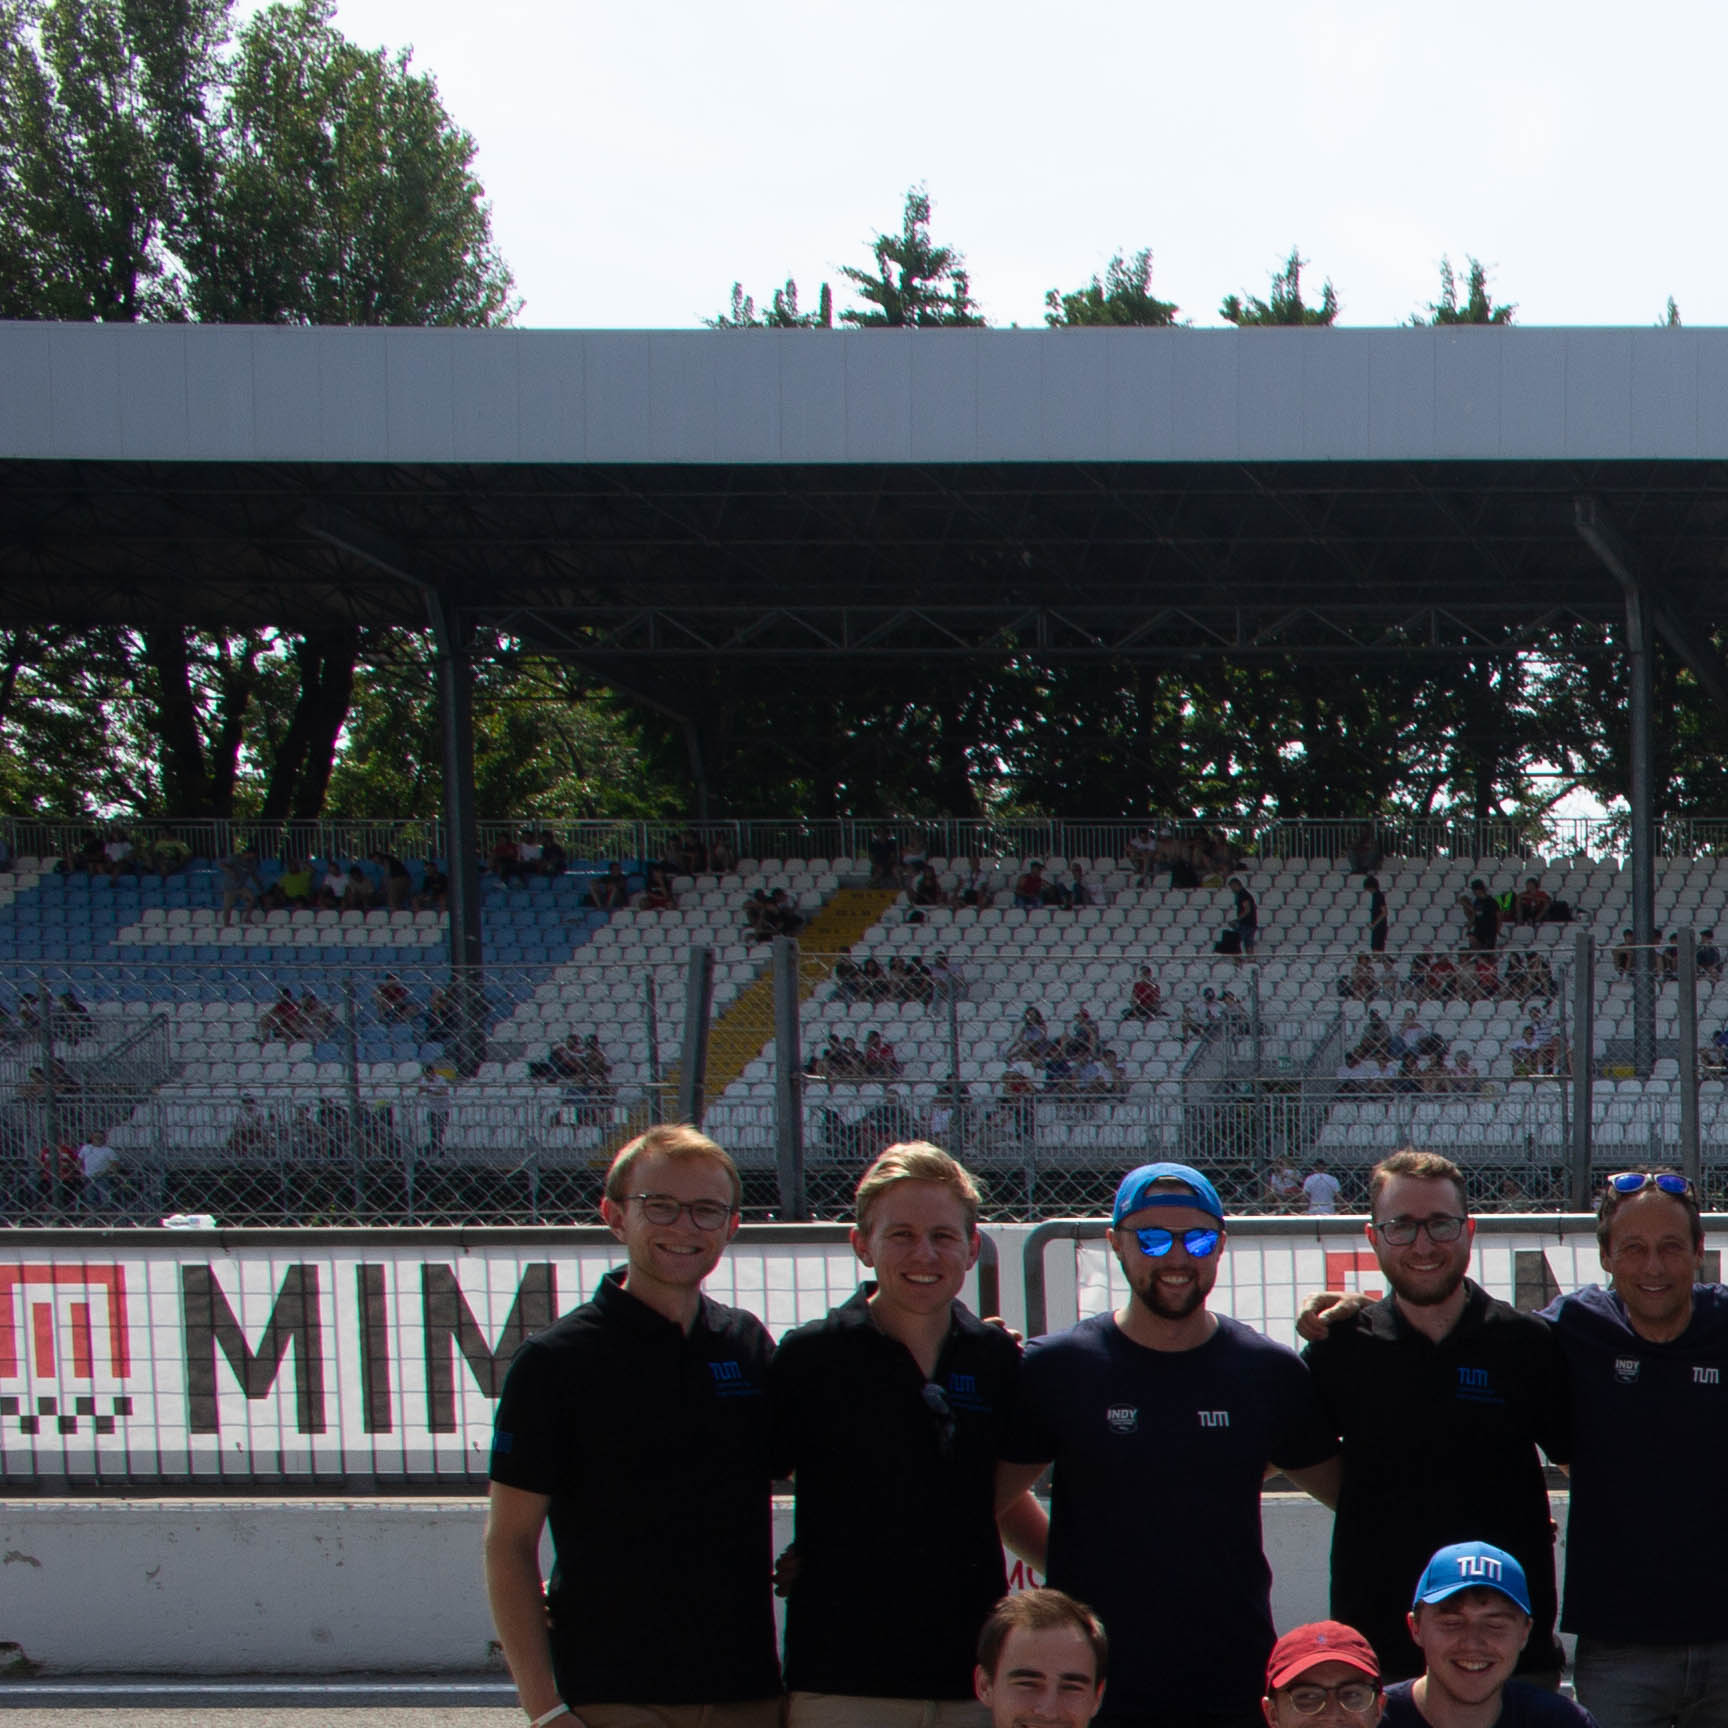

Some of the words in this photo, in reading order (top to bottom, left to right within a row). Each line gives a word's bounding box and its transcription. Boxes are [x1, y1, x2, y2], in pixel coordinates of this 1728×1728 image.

[1693, 1367, 1719, 1384] TUM
[1197, 1411, 1230, 1428] TUM
[1457, 1556, 1502, 1580] TUM
